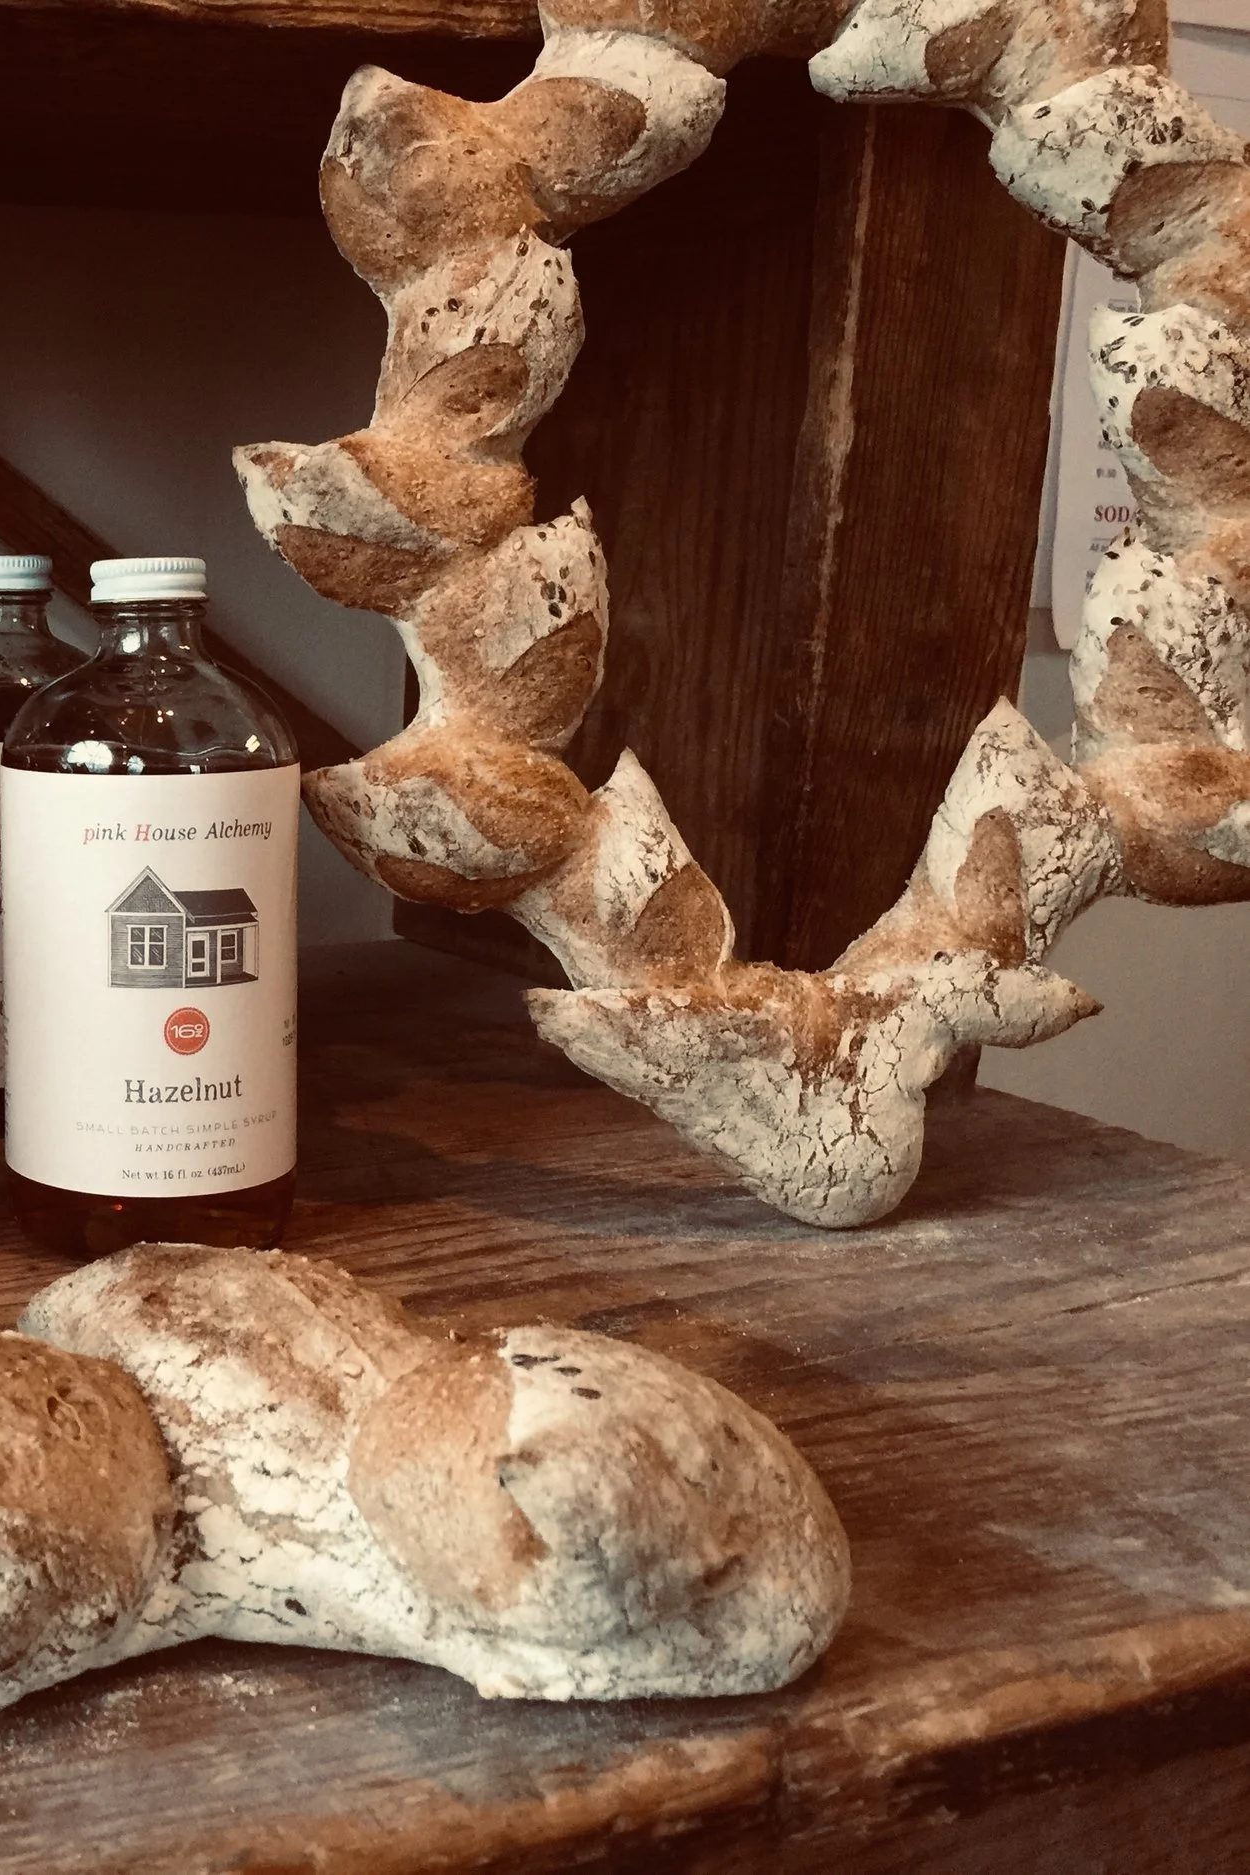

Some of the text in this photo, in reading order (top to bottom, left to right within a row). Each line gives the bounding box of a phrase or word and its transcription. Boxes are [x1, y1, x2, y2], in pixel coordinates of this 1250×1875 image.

[83, 819, 272, 845] pink House Alchemy
[124, 1074, 243, 1104] Hazelnut
[76, 1110, 277, 1136] SMALL BATCH SIMPLE SYRUP
[134, 1138, 236, 1152] HANDCRAFTED
[122, 1169, 141, 1180] Net
[145, 1170, 158, 1180] wt
[162, 1170, 174, 1180] 16
[191, 1168, 203, 1178] oz
[207, 1161, 246, 1176] (437mL)
